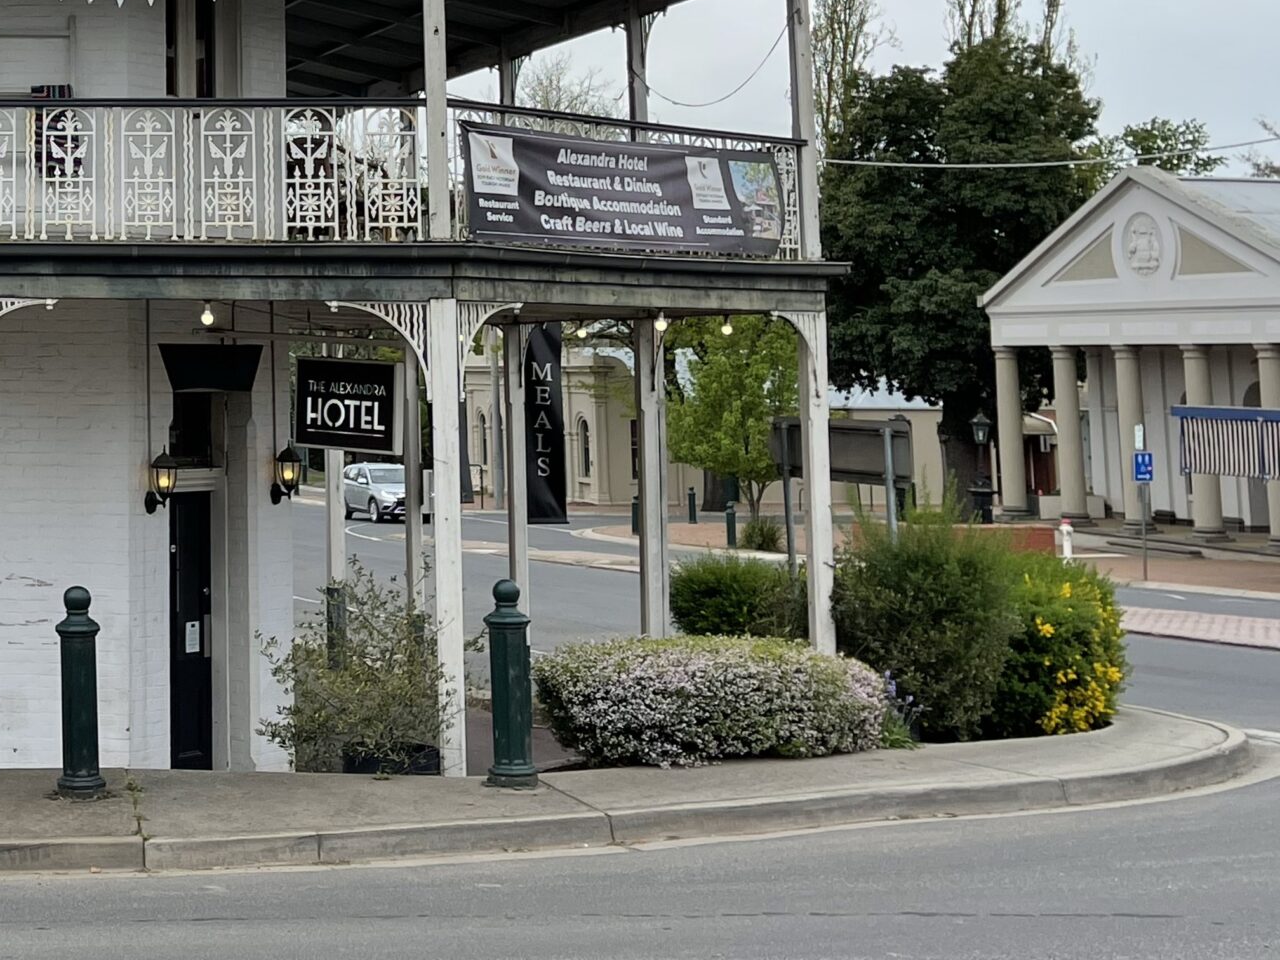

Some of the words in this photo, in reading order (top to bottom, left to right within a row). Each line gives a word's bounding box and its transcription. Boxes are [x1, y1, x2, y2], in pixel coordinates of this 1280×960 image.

[557, 148, 615, 168] Alexandra
[618, 154, 648, 171] Hotel
[546, 170, 612, 190] Restaurant
[613, 176, 623, 191] &
[624, 176, 663, 197] Dining
[478, 197, 520, 210] Restaurant
[534, 190, 591, 212] Boutique
[592, 195, 682, 216] Accommodation
[486, 211, 514, 223] Service
[540, 214, 573, 232] Craft
[575, 216, 611, 234] Beers
[614, 218, 623, 235] &
[624, 219, 655, 236] Local
[654, 221, 684, 238] Wine
[307, 379, 327, 393] THE
[329, 381, 387, 397] ALEXANDRA
[306, 396, 386, 431] HOTEL
[531, 361, 553, 477] MEALS
